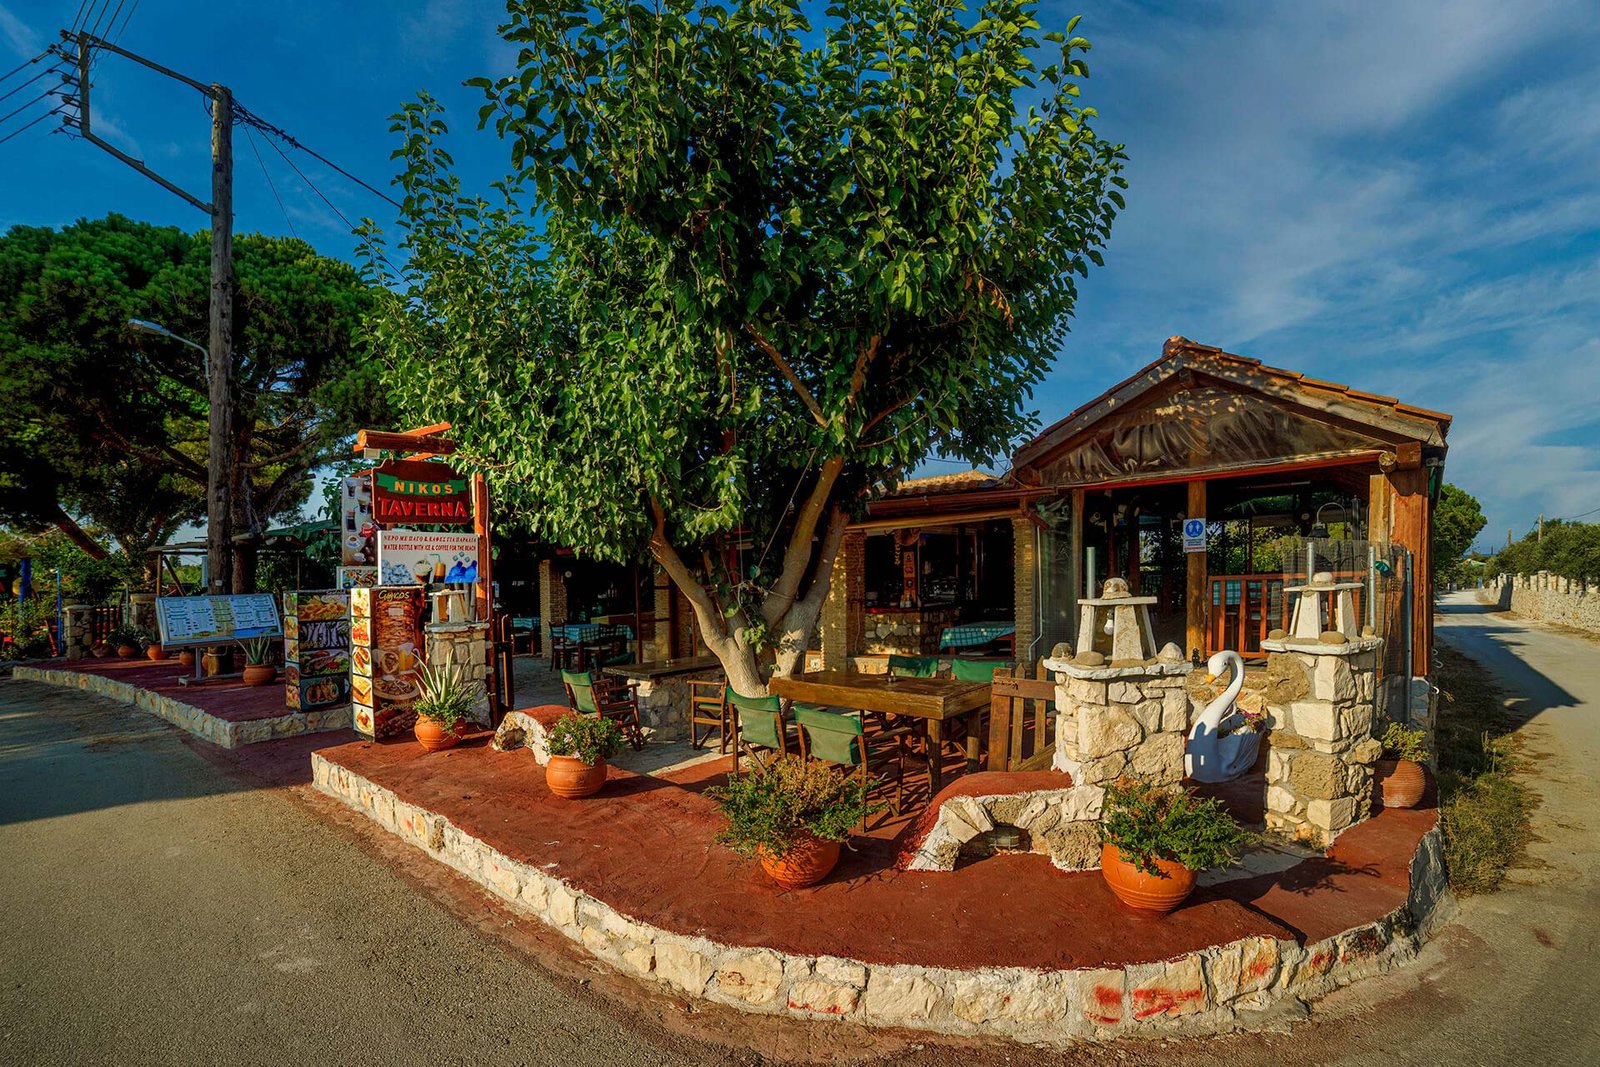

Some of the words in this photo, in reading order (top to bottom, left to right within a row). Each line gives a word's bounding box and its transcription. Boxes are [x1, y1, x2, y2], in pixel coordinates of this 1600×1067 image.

[395, 482, 453, 494] NIKOS
[378, 498, 467, 517] TAVERNA
[378, 590, 410, 602] Gyros
